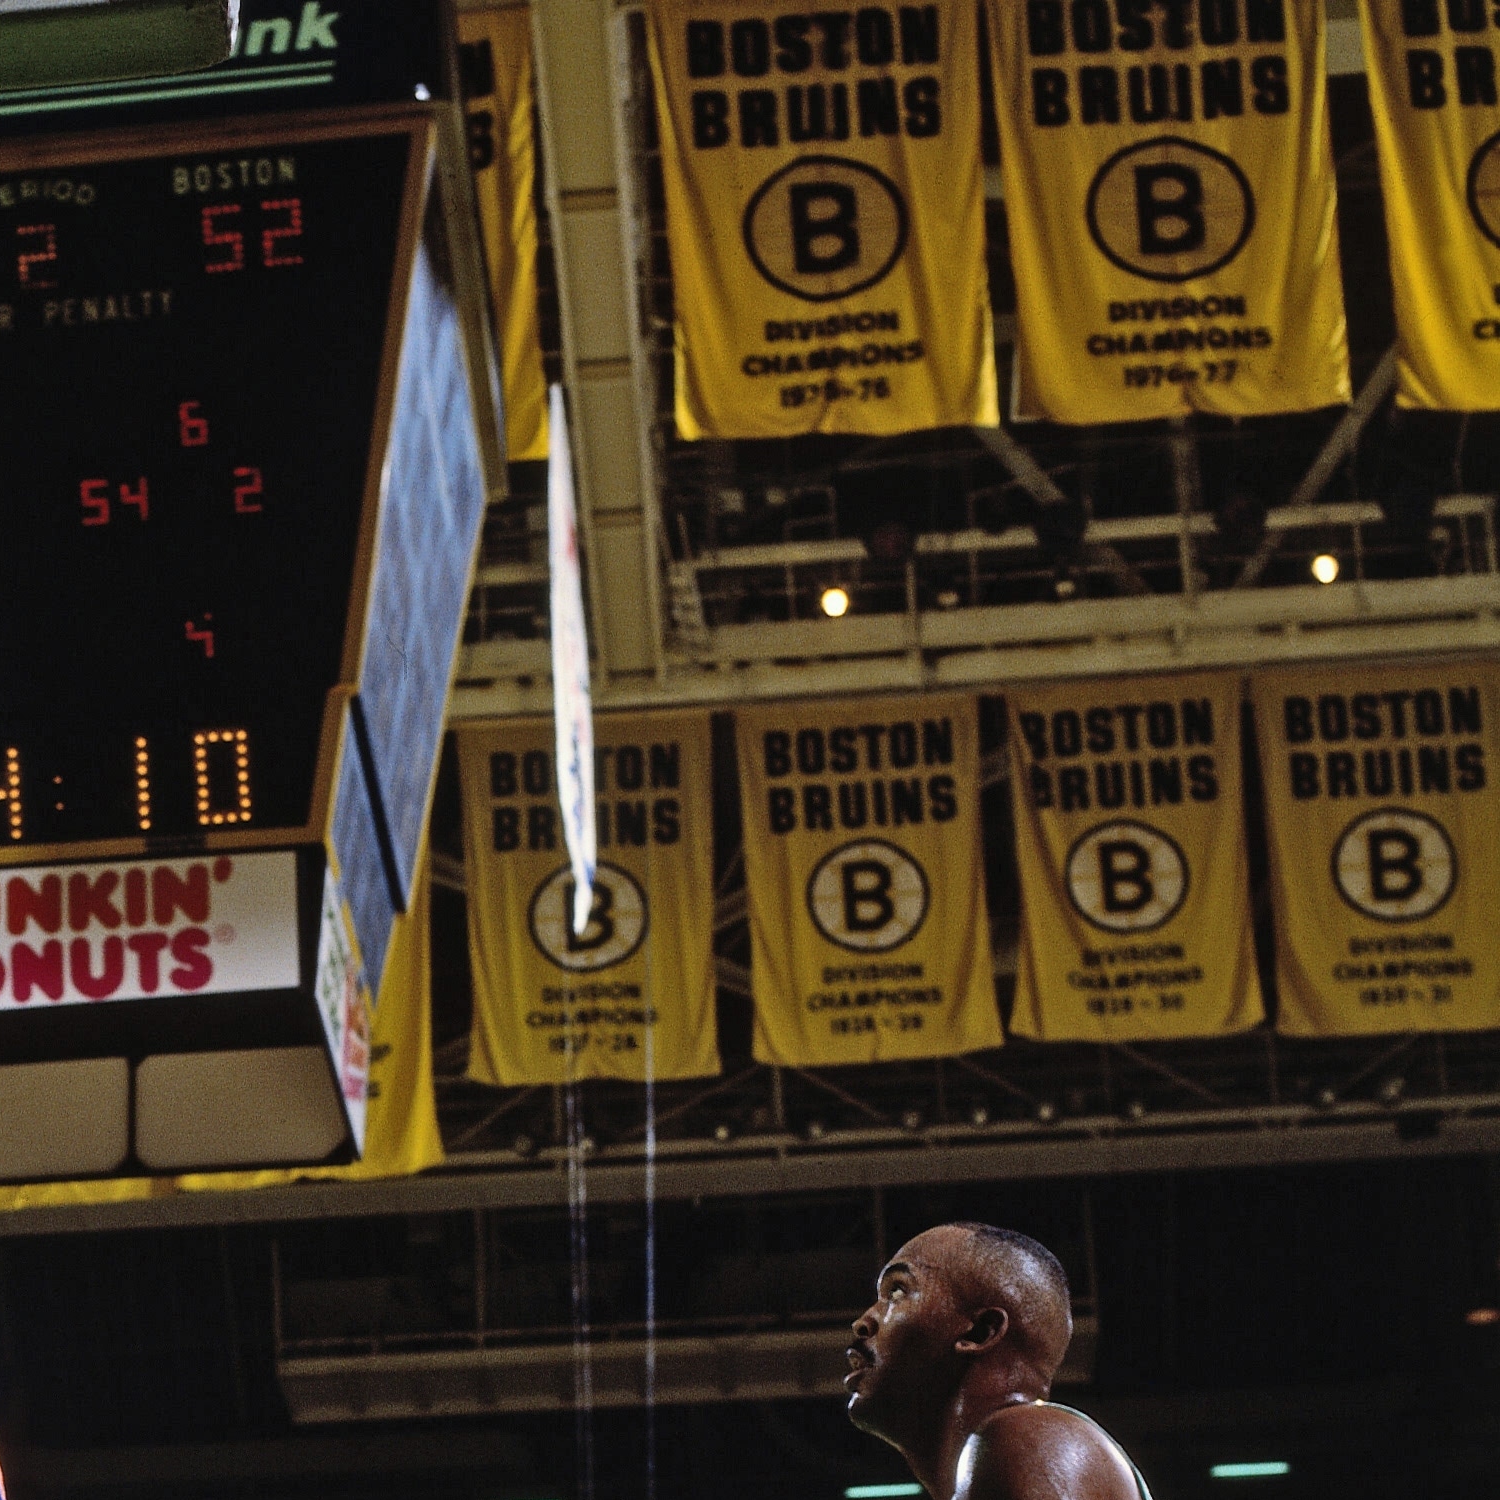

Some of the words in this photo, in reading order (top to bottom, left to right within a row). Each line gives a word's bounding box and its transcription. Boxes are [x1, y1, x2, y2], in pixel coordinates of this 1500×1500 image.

[687, 5, 940, 78] BOSTON
[1027, 0, 1285, 55] BOSTON
[691, 75, 941, 149] BRUINS
[1032, 55, 1290, 127] BRUINS
[173, 158, 296, 195] BOSTON
[202, 199, 303, 273] 52
[790, 181, 860, 274] B
[1135, 163, 1205, 255] B
[17, 224, 57, 289] 2
[44, 290, 172, 325] PENALTY
[764, 311, 898, 342] DIVISION
[1109, 296, 1246, 322] DIVISION
[742, 340, 925, 376] CHAMPIONS
[1086, 327, 1273, 356] CHAMPIONS
[179, 401, 208, 447] 6
[80, 476, 148, 526] 54
[234, 467, 263, 513] 2
[1020, 699, 1214, 760] BOSTON
[1284, 686, 1482, 744] BOSTON
[764, 717, 953, 778] BOSTON
[1291, 744, 1486, 800] BRUINS
[493, 798, 682, 851] BRINS
[769, 775, 958, 834] BRUINS
[1100, 841, 1153, 913] B
[1368, 828, 1422, 901] B
[842, 861, 894, 931] B
